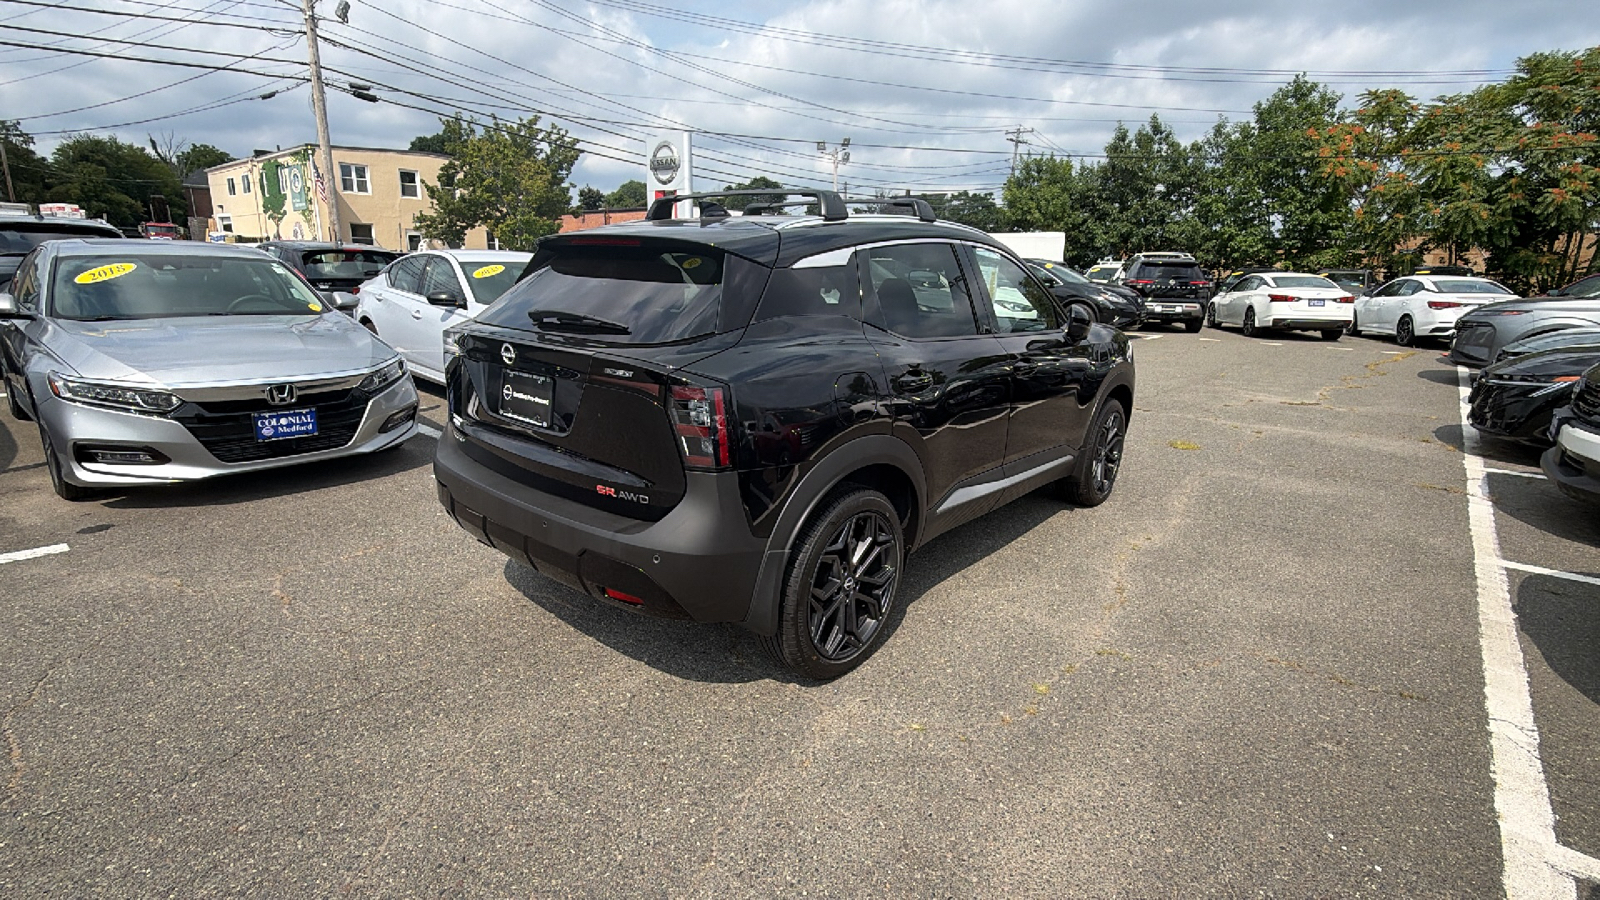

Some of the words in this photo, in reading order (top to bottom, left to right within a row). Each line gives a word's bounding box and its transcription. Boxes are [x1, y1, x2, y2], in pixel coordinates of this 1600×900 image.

[650, 157, 679, 168] NISSAN
[88, 265, 126, 281] 2018
[258, 415, 314, 427] COLONIAL
[278, 423, 313, 433] Medford
[596, 485, 617, 497] SR
[618, 491, 649, 504] AWD
